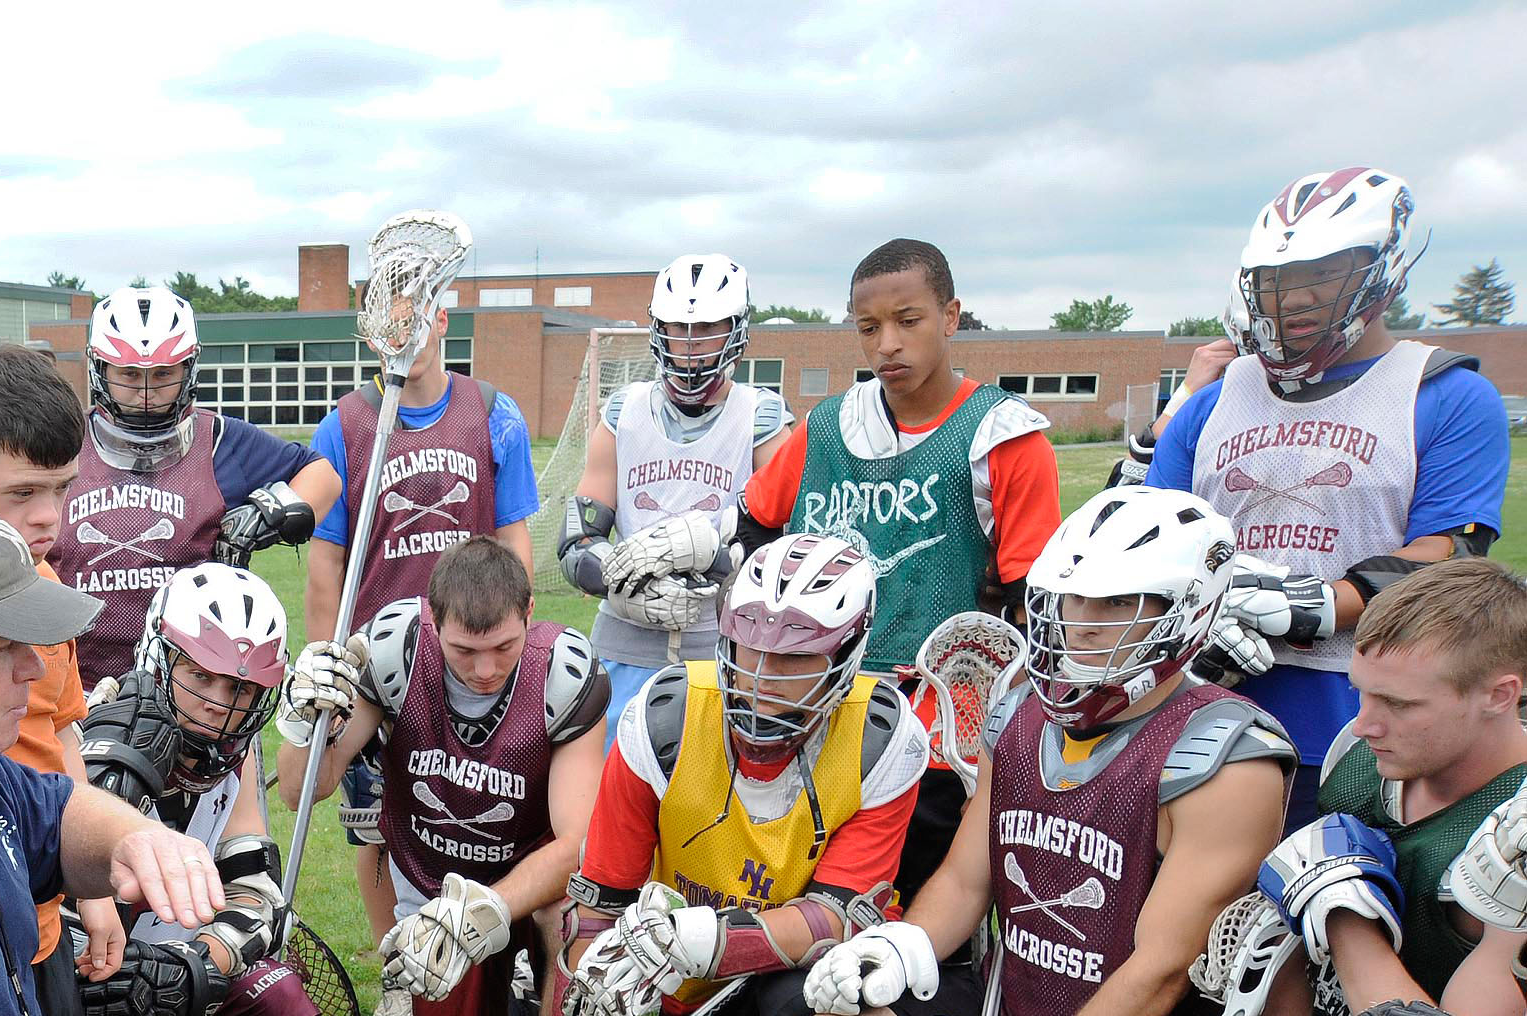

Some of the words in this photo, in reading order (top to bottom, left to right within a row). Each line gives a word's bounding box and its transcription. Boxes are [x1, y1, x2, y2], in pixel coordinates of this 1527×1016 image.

[1215, 420, 1378, 471] CHELMSFORD
[380, 448, 478, 495] HELMSFORD
[627, 459, 733, 492] CHELMSFORD
[68, 484, 186, 525] CHELMSFORD
[804, 473, 939, 533] RAPTORS
[1236, 523, 1340, 553] ACROSSE
[407, 748, 526, 800] CHELMSFORD
[411, 814, 515, 862] LACROSSE
[999, 810, 1124, 881] CHELMSFORD
[1004, 917, 1104, 983] LACROSSE
